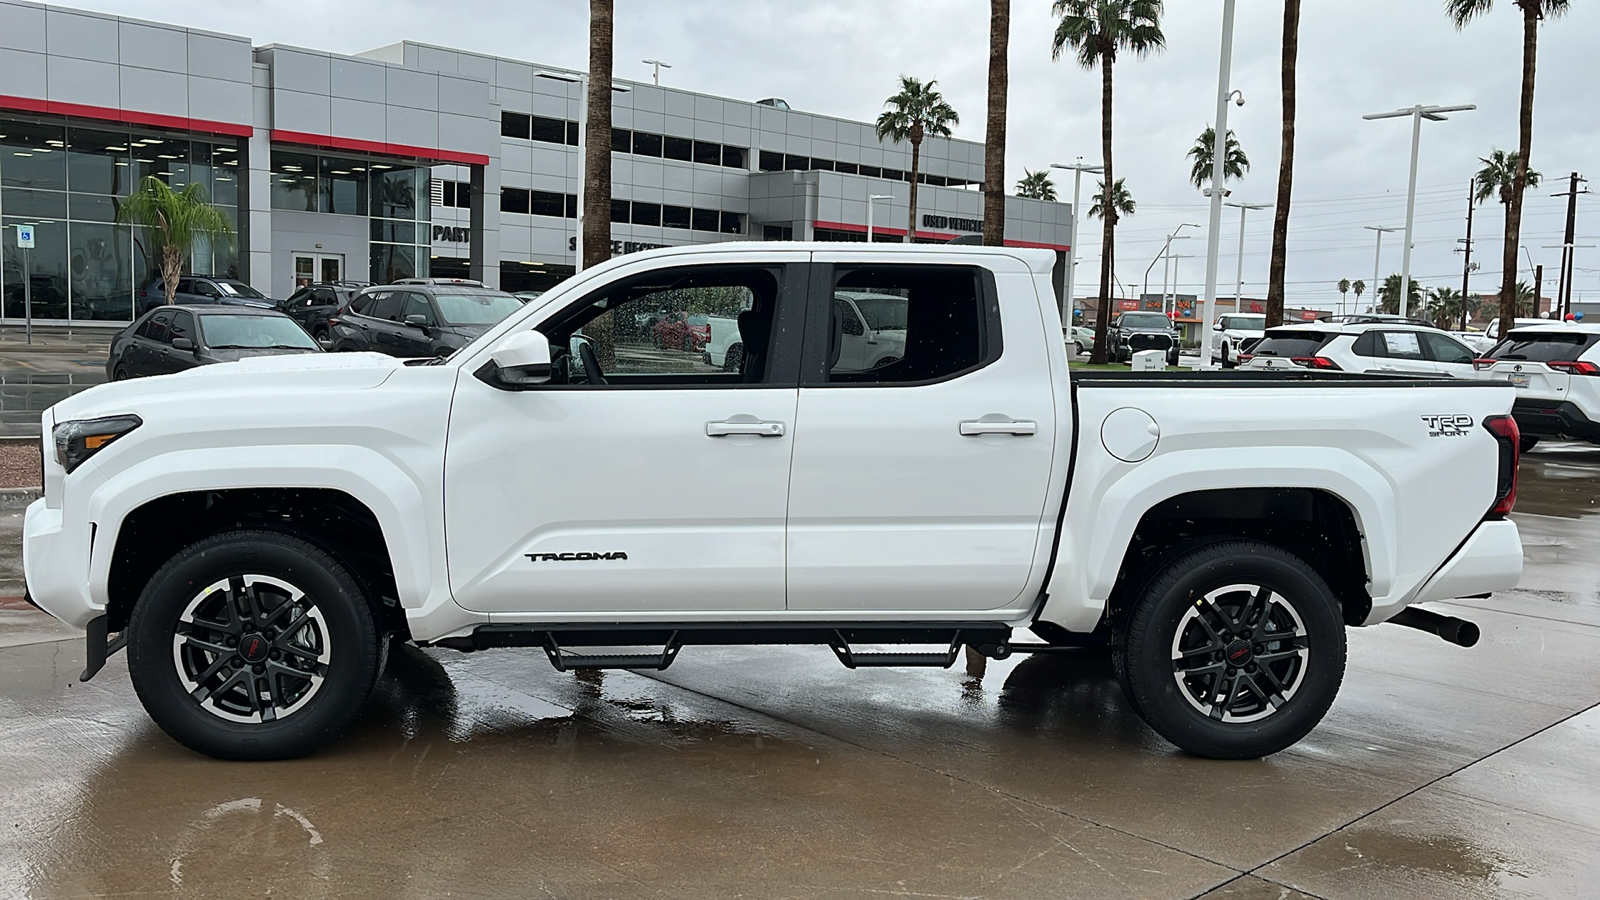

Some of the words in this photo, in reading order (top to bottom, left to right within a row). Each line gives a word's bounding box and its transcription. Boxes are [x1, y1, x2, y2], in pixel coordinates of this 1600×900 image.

[923, 214, 948, 229] USED
[948, 216, 985, 233] VEHICLE
[432, 225, 470, 243] PART
[1421, 414, 1474, 431] TRD
[524, 552, 628, 562] TACOMA
